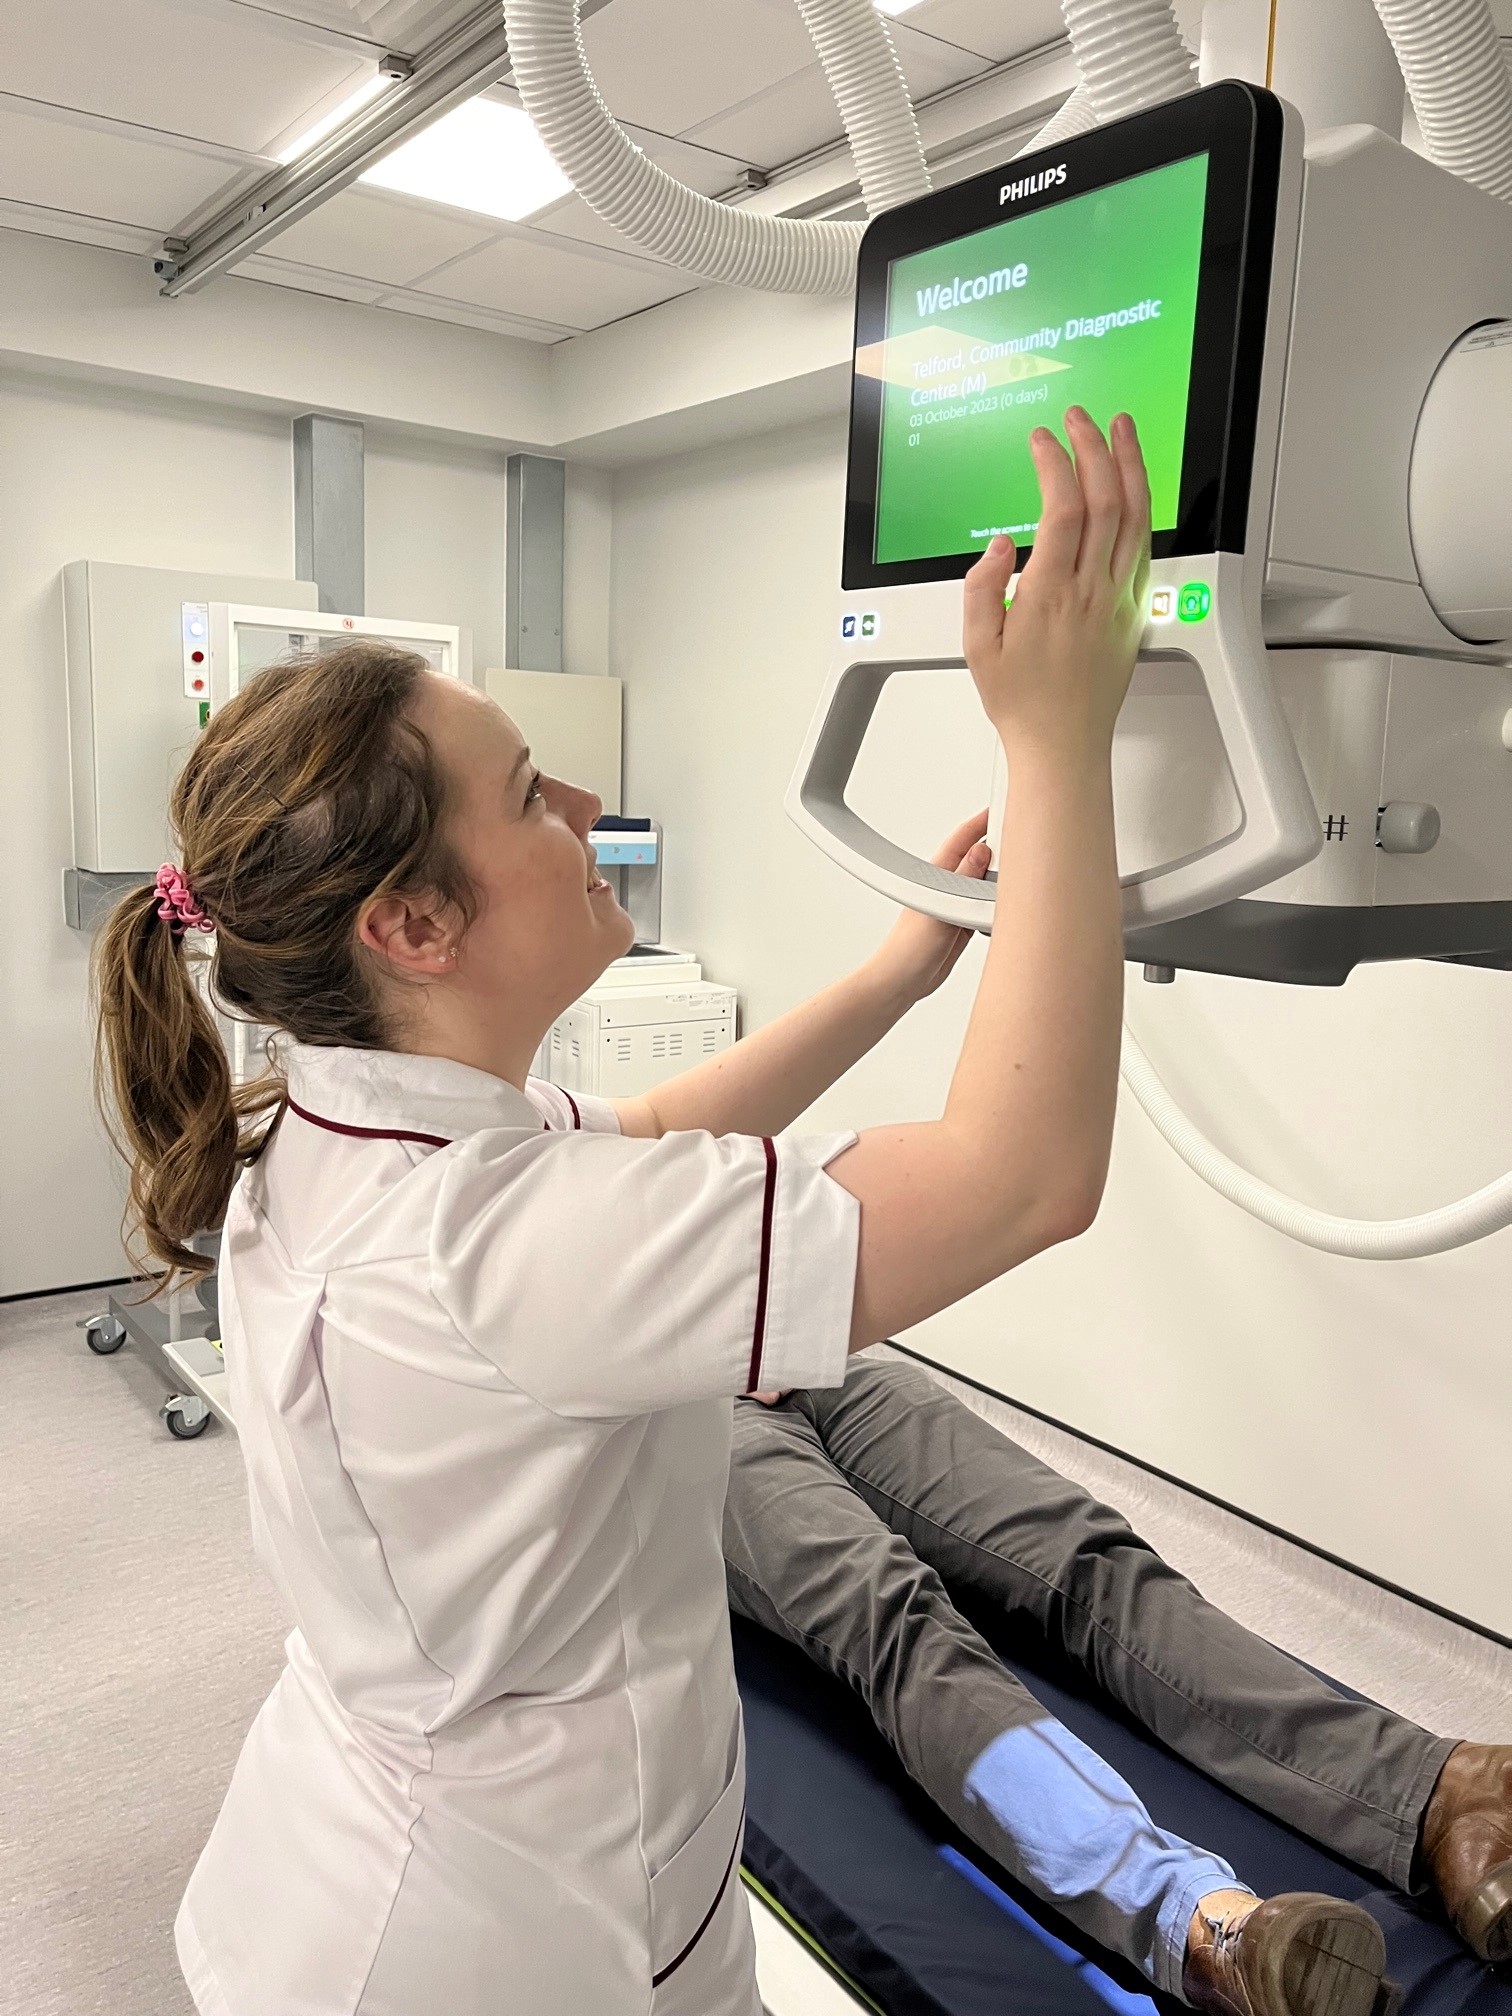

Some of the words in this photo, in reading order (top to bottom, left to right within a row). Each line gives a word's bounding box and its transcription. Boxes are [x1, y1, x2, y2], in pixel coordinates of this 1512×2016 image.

[999, 163, 1067, 206] PHILIPS
[916, 263, 1029, 317] Welcome
[912, 352, 966, 380] Telford,
[969, 327, 1061, 365] Community
[1065, 299, 1162, 341] Diagnostic
[909, 413, 923, 428] 03
[925, 402, 968, 425] October
[970, 396, 998, 415] 2023
[1000, 392, 1013, 411] (0
[1016, 384, 1048, 405] days)
[911, 385, 958, 407] Centre
[961, 371, 987, 399] (M)
[908, 432, 921, 447] 01
[971, 528, 989, 538] Touch
[1002, 525, 1023, 534] screen
[1024, 523, 1031, 531] to
